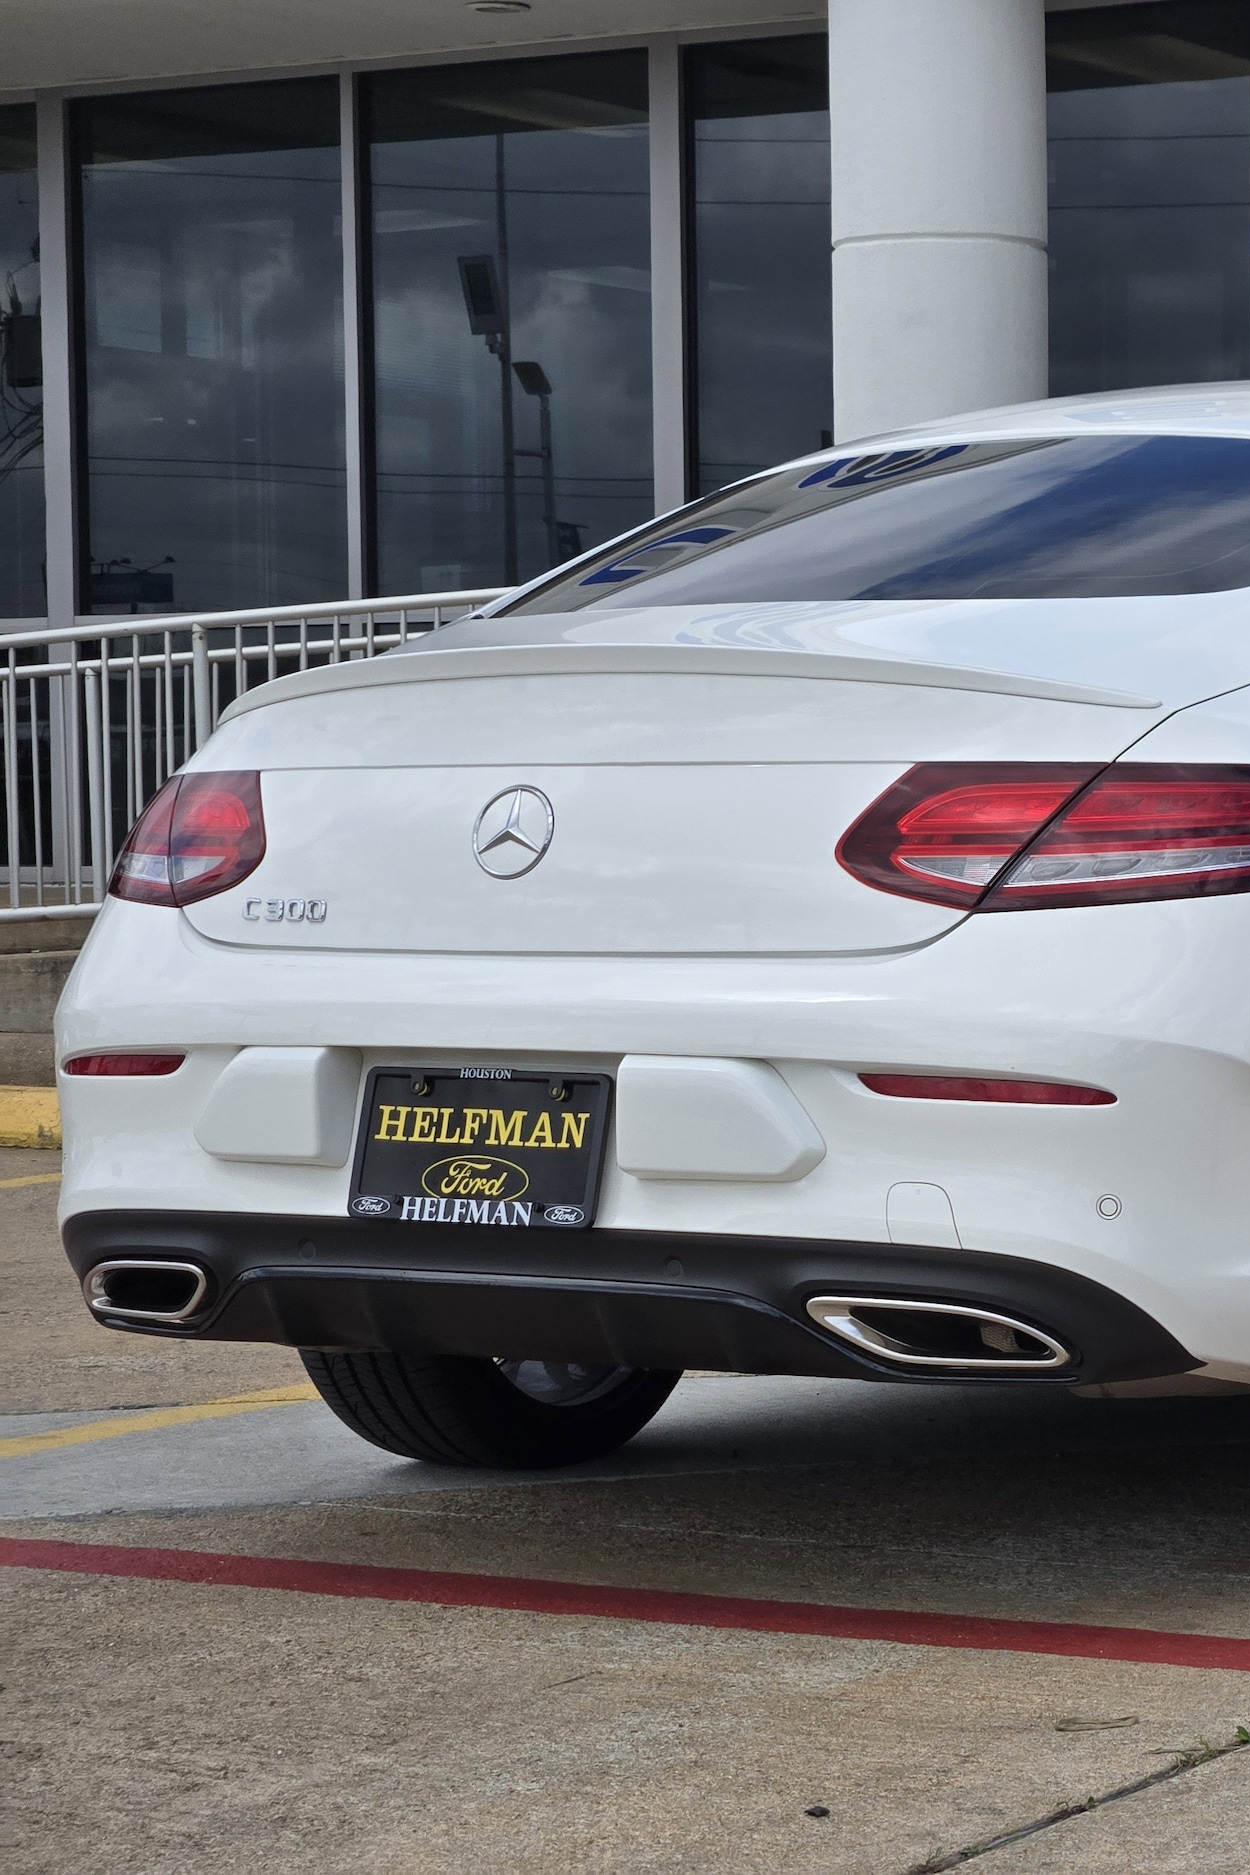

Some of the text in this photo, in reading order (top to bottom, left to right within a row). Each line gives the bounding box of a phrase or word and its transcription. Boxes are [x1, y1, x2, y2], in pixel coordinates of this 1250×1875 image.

[460, 1068, 512, 1080] HOUSTON
[374, 1104, 590, 1149] HELFMAN
[440, 1161, 508, 1196] Ford
[358, 1196, 577, 1226] Ford HELFMAN Ford
